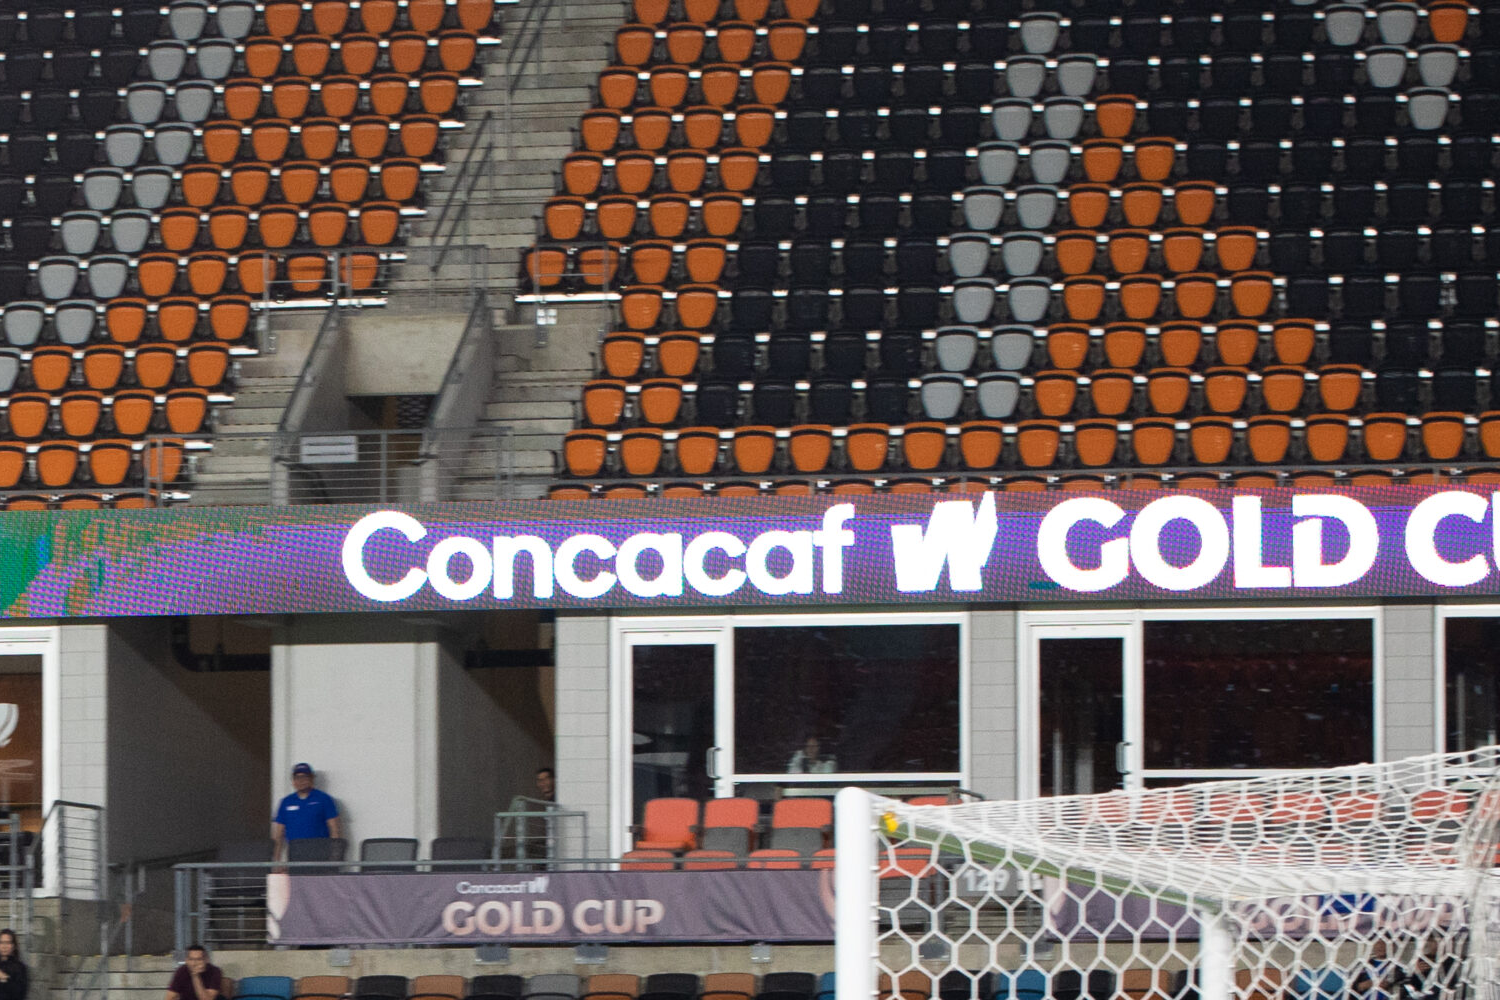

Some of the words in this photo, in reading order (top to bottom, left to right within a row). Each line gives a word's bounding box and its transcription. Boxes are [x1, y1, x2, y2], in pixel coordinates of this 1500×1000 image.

[342, 503, 855, 602] Concacaf
[1037, 494, 1380, 592] GOLD
[1404, 490, 1500, 588] C
[456, 881, 528, 894] Concacaf
[442, 900, 565, 936] GOLD
[572, 899, 665, 934] CUP
